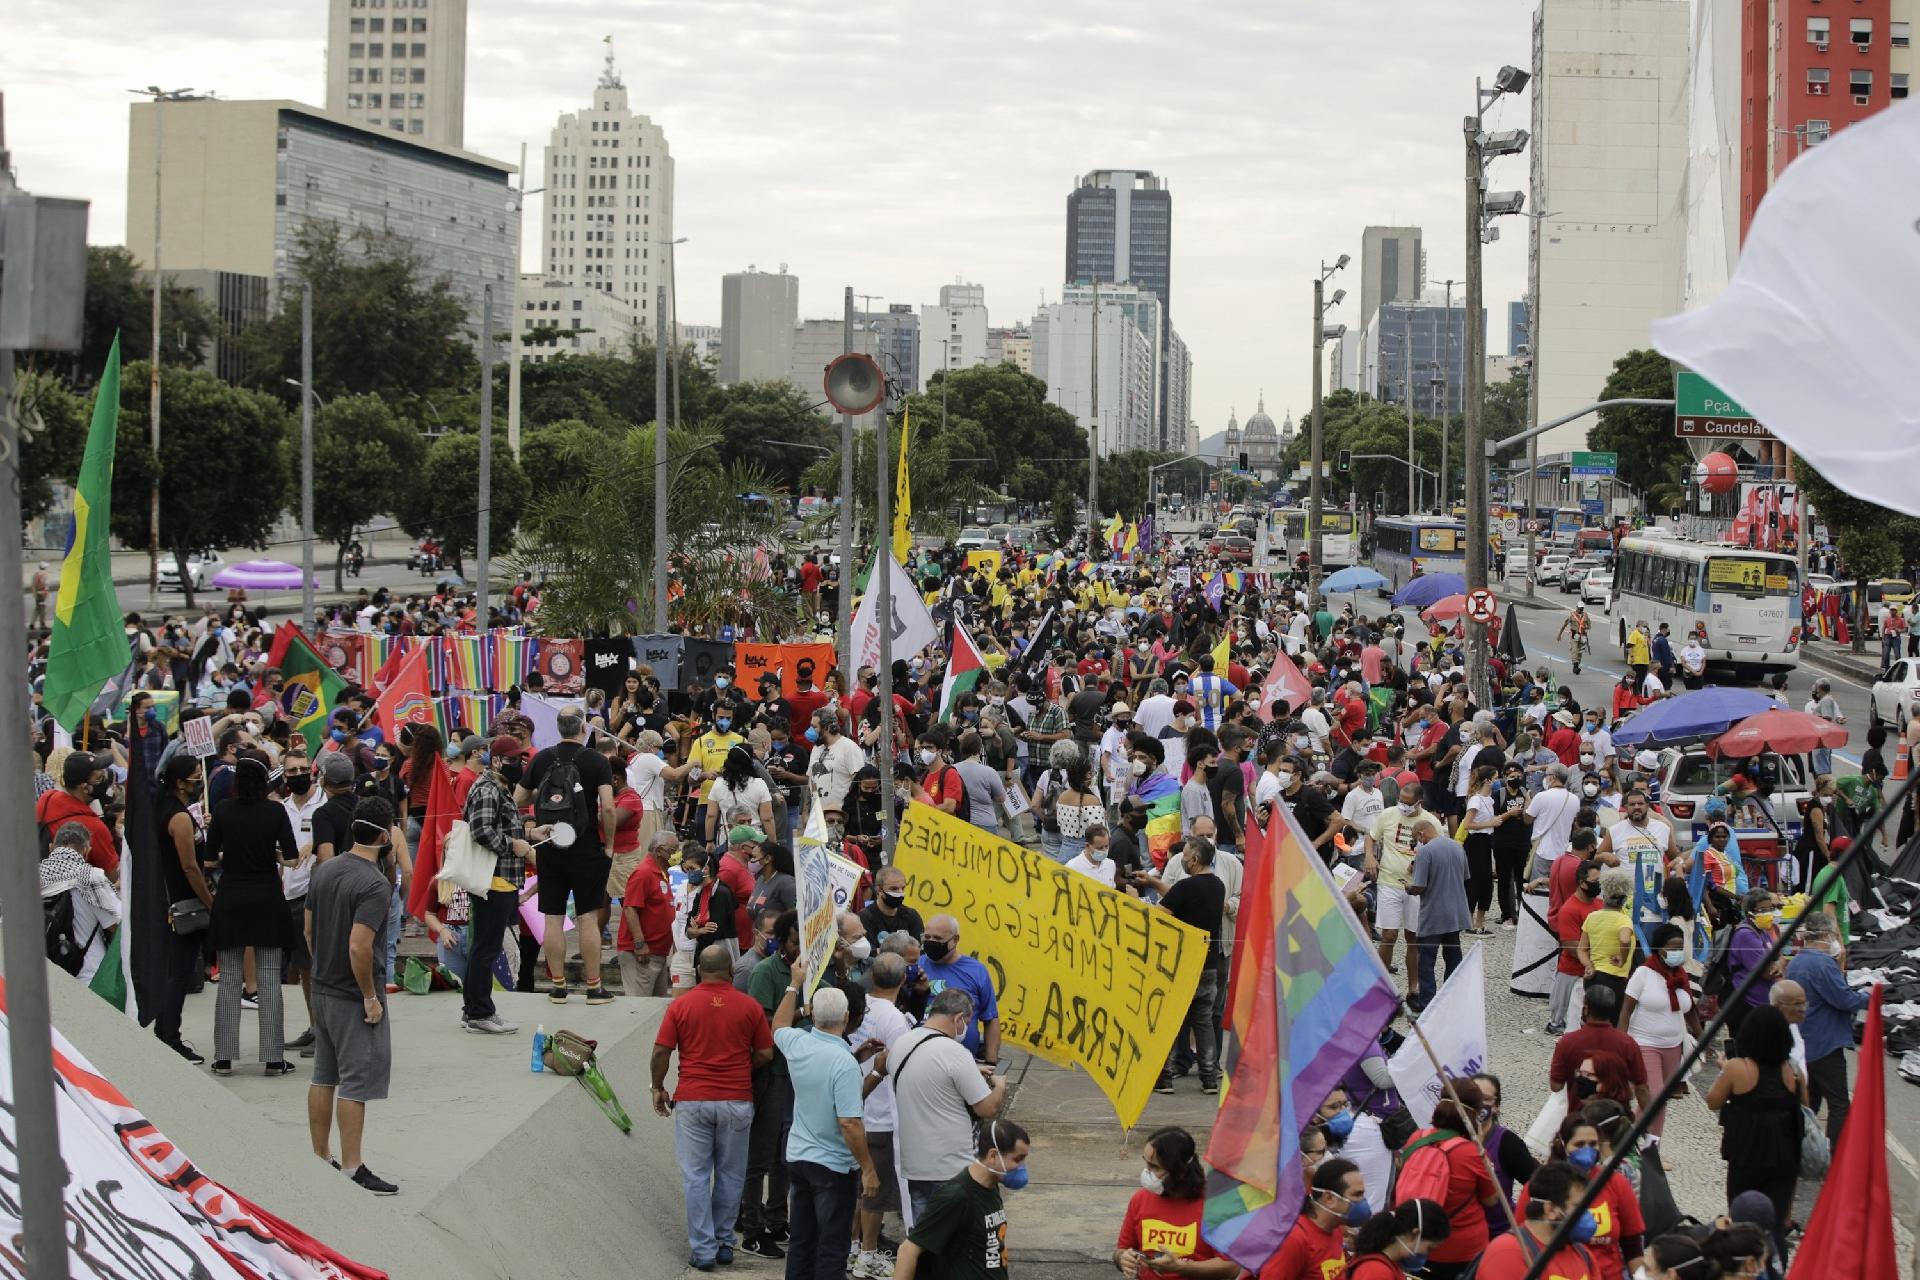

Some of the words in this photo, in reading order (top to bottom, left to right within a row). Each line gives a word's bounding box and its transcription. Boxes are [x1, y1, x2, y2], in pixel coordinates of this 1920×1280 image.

[1704, 400, 1735, 414] Pça.
[1705, 421, 1770, 434] Candelár
[1758, 610, 1784, 619] C47607
[185, 718, 211, 746] FORA
[1148, 1228, 1188, 1247] PSTU
[985, 1230, 1001, 1269] REAGE
